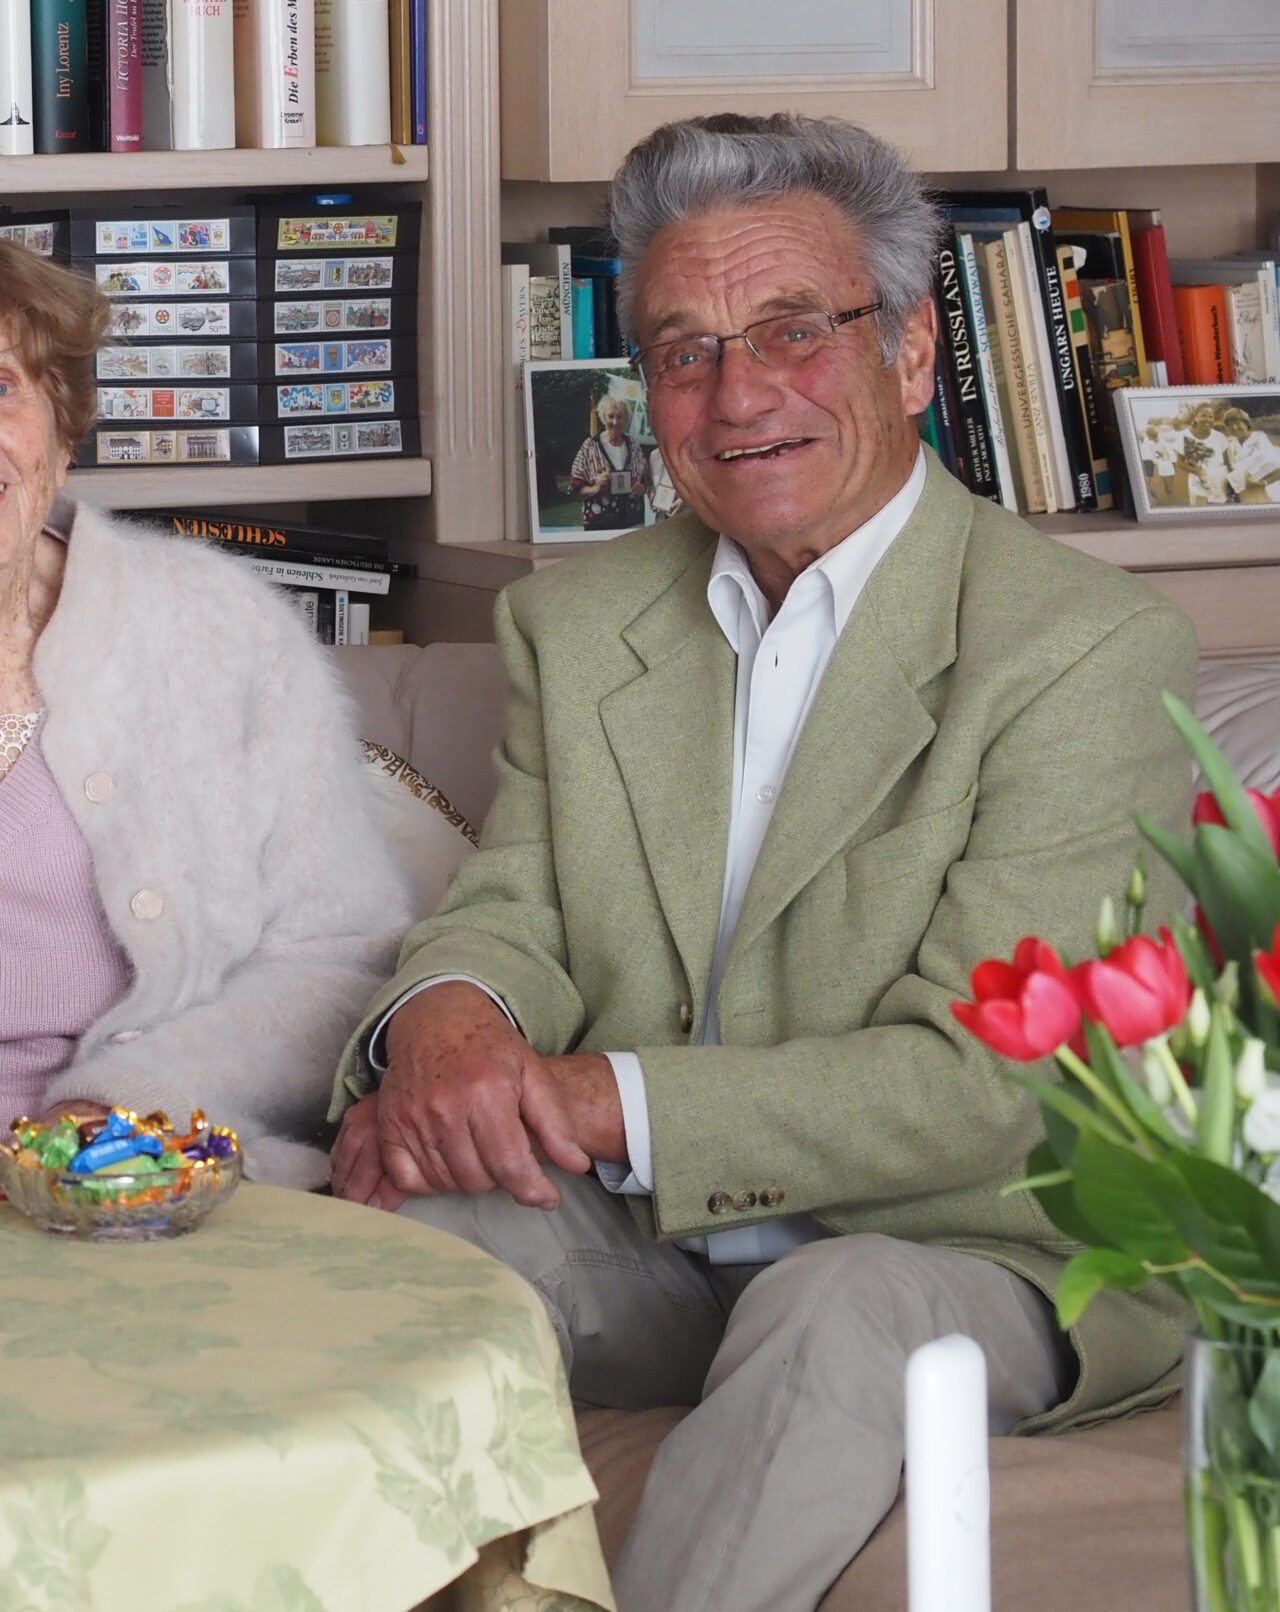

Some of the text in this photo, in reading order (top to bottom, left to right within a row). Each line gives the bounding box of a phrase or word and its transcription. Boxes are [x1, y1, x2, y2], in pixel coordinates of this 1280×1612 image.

[286, 12, 298, 34] des
[55, 22, 73, 98] Iny Lorentz
[283, 37, 299, 79] Erben
[288, 81, 299, 104] Die
[996, 246, 1014, 307] SAHARA
[967, 252, 990, 352] SCHWARZWALD
[939, 250, 977, 402] IN RUSSLAND
[1046, 265, 1074, 391] UNGARN HEUTE
[1079, 472, 1092, 499] 1980
[172, 517, 287, 547] SCHLESIEN
[275, 567, 285, 575] in
[286, 567, 324, 582] Schlesien
